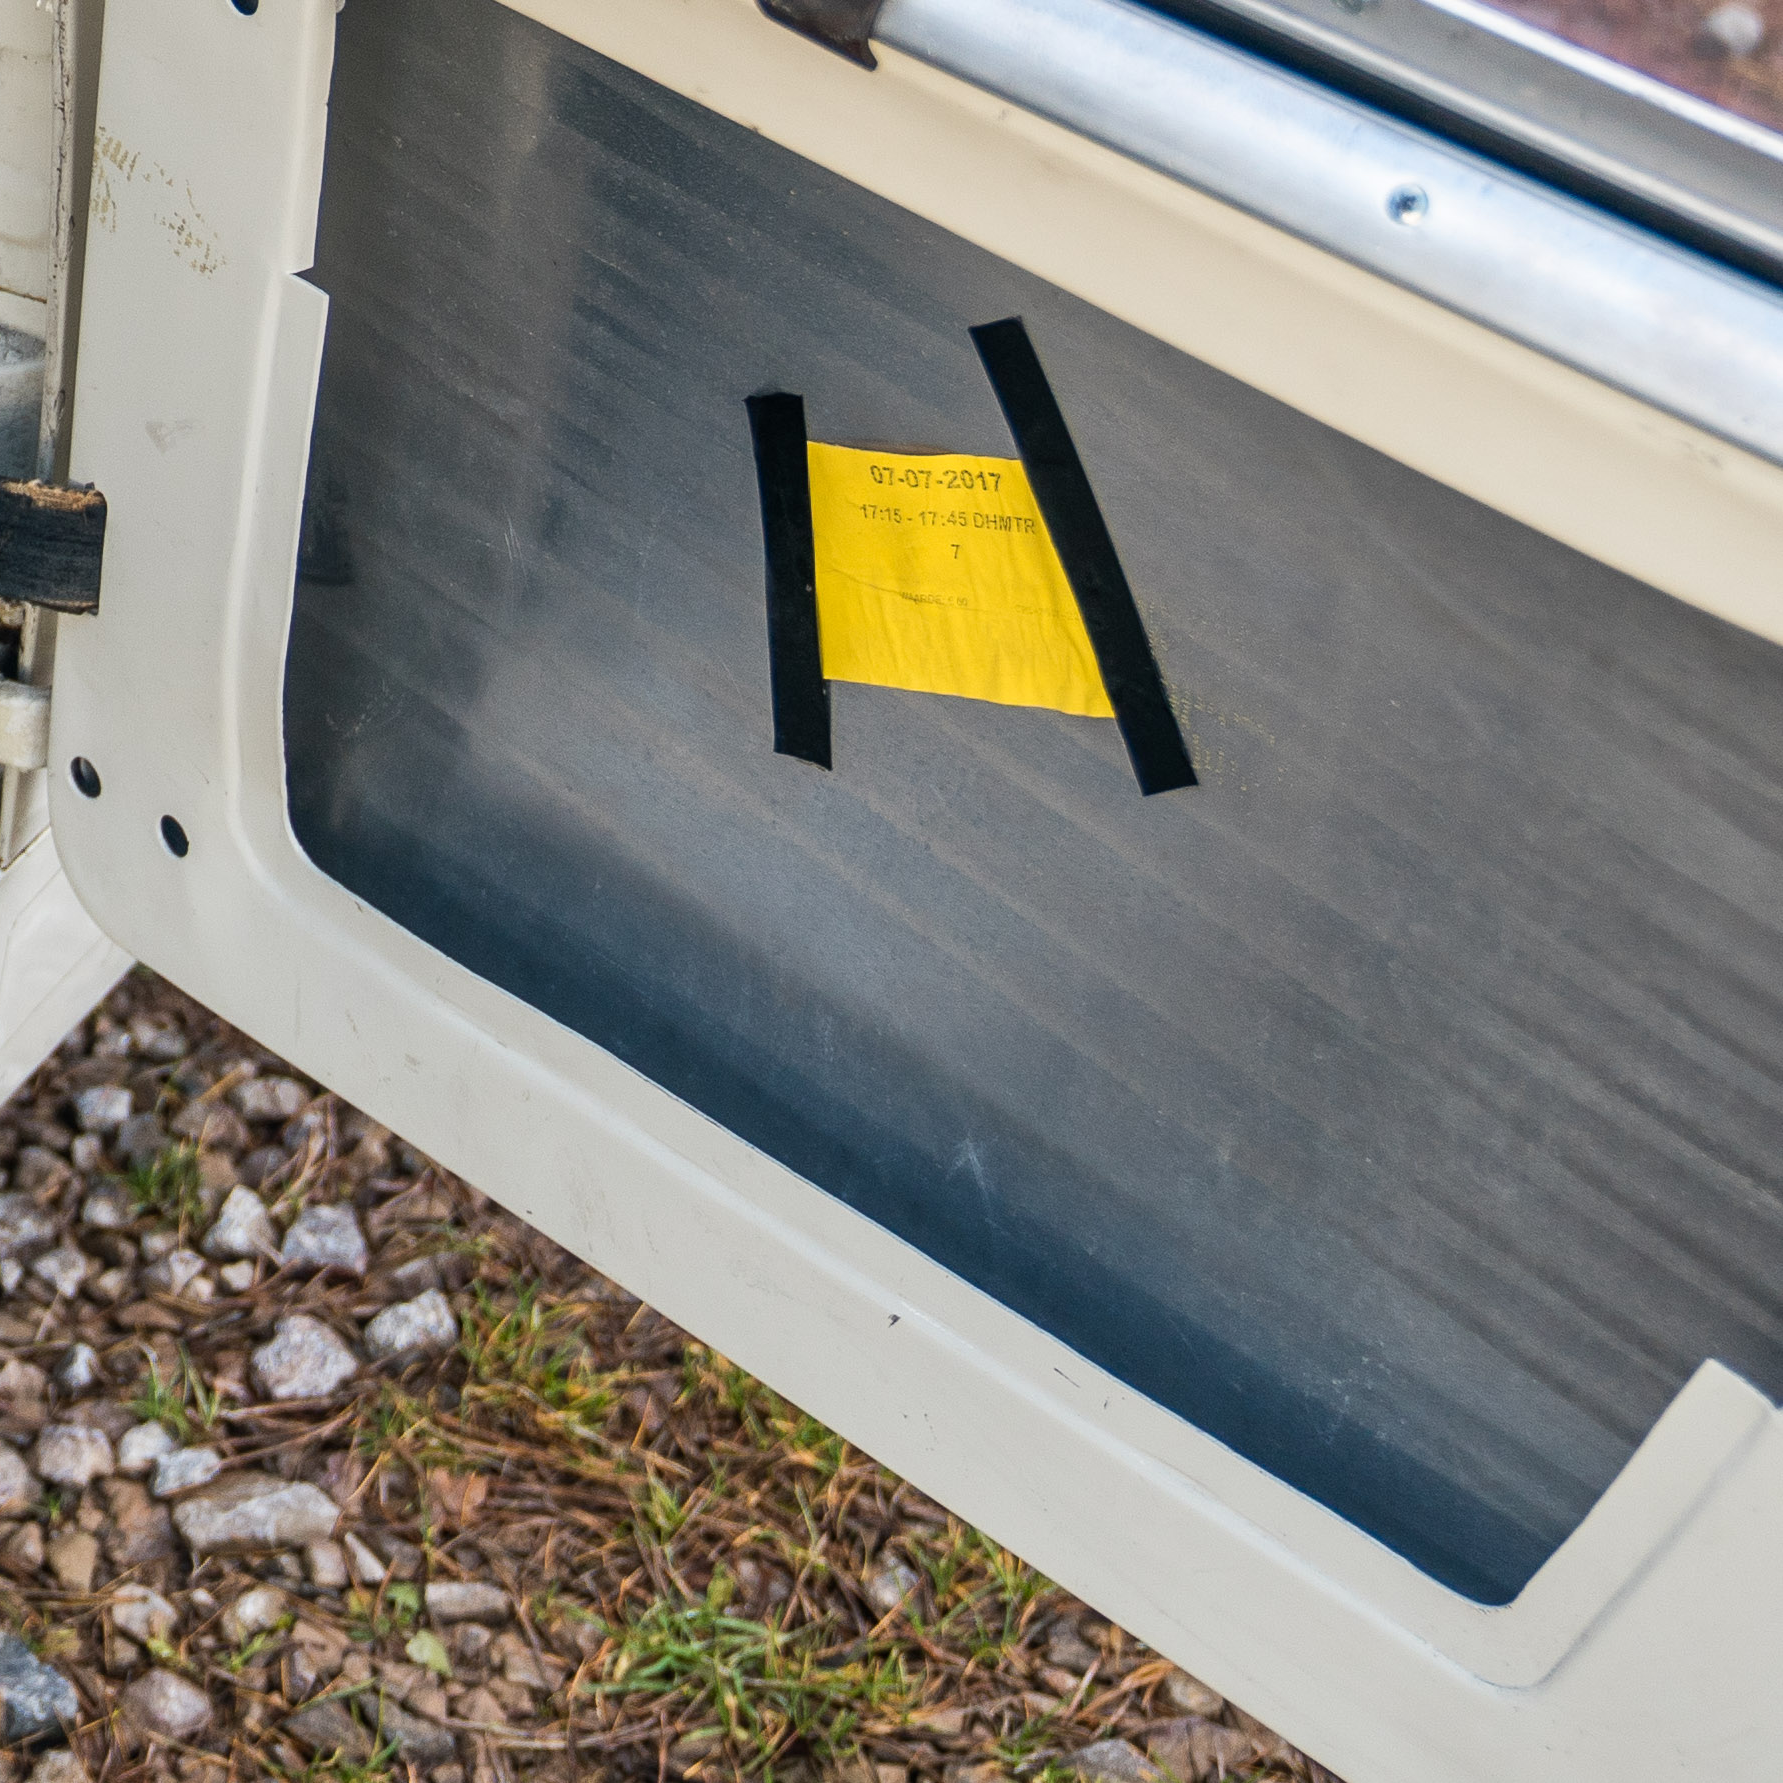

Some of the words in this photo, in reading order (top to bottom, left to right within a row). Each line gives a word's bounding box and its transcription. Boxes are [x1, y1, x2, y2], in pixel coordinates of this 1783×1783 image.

[870, 464, 1002, 493] 07-07-2017
[860, 504, 901, 524] 17:15
[918, 510, 968, 528] 17:45
[972, 512, 1037, 535] DHMTR
[950, 544, 961, 560] 7
